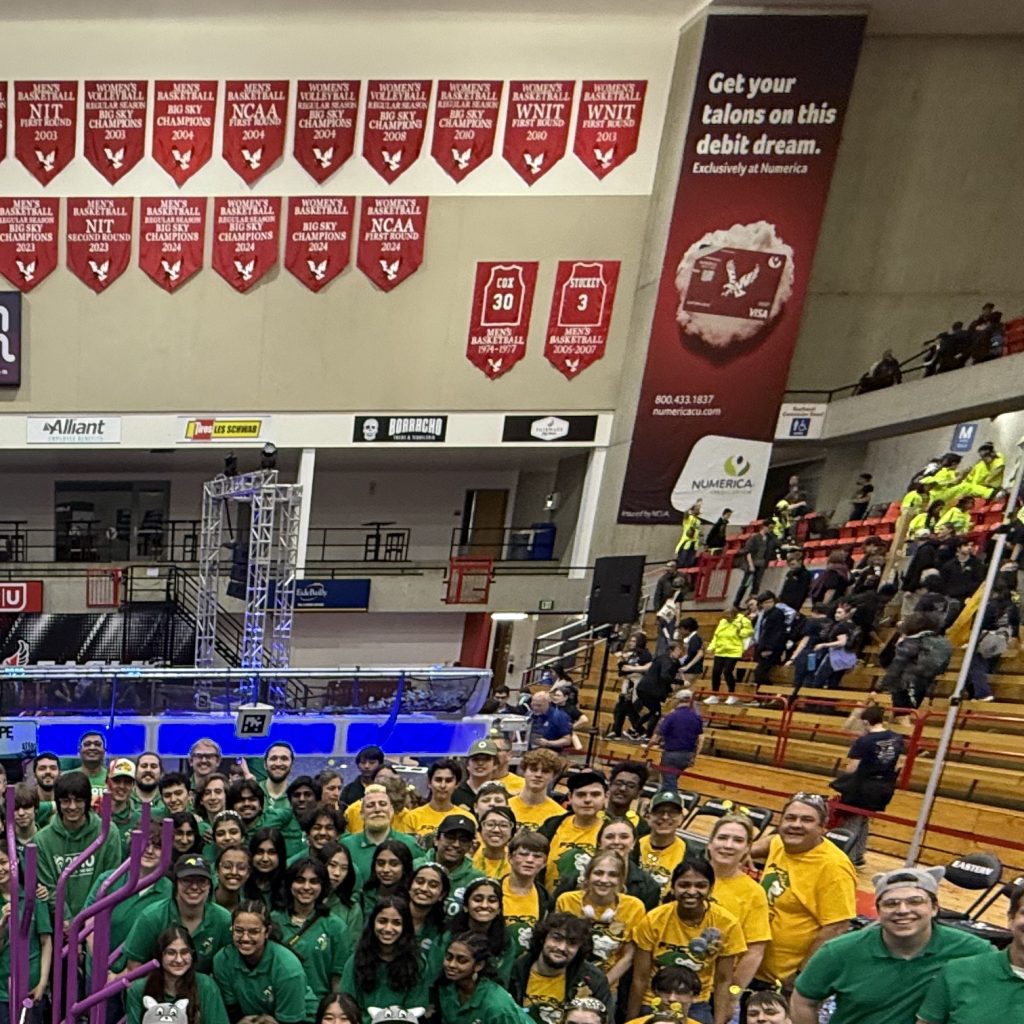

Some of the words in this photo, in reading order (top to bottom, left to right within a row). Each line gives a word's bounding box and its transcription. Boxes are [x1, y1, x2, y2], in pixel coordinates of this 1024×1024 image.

[709, 72, 745, 94] Get
[747, 77, 796, 99] your
[30, 104, 63, 120] NIT
[168, 105, 182, 115] BIG
[185, 105, 202, 115] SKY
[232, 104, 277, 120] NCAA
[516, 104, 565, 120] WNIT
[587, 104, 636, 120] WNIT
[703, 103, 765, 124] talons
[770, 109, 793, 124] on
[798, 102, 837, 124] this
[157, 117, 211, 127] CHAMPIONS
[697, 134, 750, 154] debit
[753, 134, 821, 154] dream.
[693, 162, 746, 176] Exclusively
[748, 164, 758, 173] at
[761, 163, 808, 174] Numerica
[0, 207, 53, 216] BASKETBALL
[74, 207, 127, 216] BASKETBALL
[147, 207, 200, 216] BASKETBALL
[220, 206, 274, 215] BASKETBALL
[295, 206, 348, 215] BASKETBALL
[368, 206, 421, 215] BASKETBALL
[9, 224, 24, 232] BIG
[26, 224, 43, 232] SKY
[86, 219, 114, 234] NIT
[156, 224, 171, 232] BIG
[173, 224, 188, 232] SKY
[230, 223, 244, 231] BIG
[246, 222, 263, 231] SKY
[303, 222, 317, 231] BIG
[320, 222, 337, 231] SKY
[371, 218, 414, 232] NCAA
[0, 232, 53, 242] CHAMPIONS
[68, 233, 100, 242] SECOND
[101, 233, 131, 242] ROUND
[145, 232, 199, 242] CHAMPIONS
[219, 231, 273, 241] CHAMPIONS
[292, 232, 346, 241] CHAMPIONS
[365, 232, 389, 240] FIRST
[390, 232, 419, 240] ROUND
[497, 278, 514, 288] COX
[493, 294, 514, 310] 30
[577, 294, 588, 311] 3
[749, 308, 769, 319] VISA
[565, 328, 591, 336] MEN'S
[471, 336, 524, 345] BASKETBALL
[550, 336, 603, 344] BASKETBALL
[655, 395, 714, 404] 800.433.1837
[653, 407, 721, 416] numericacu.com
[48, 419, 105, 434] Alliant
[388, 418, 442, 436] BORRACHO
[959, 426, 973, 439] M
[692, 479, 752, 489] NUMERICA
